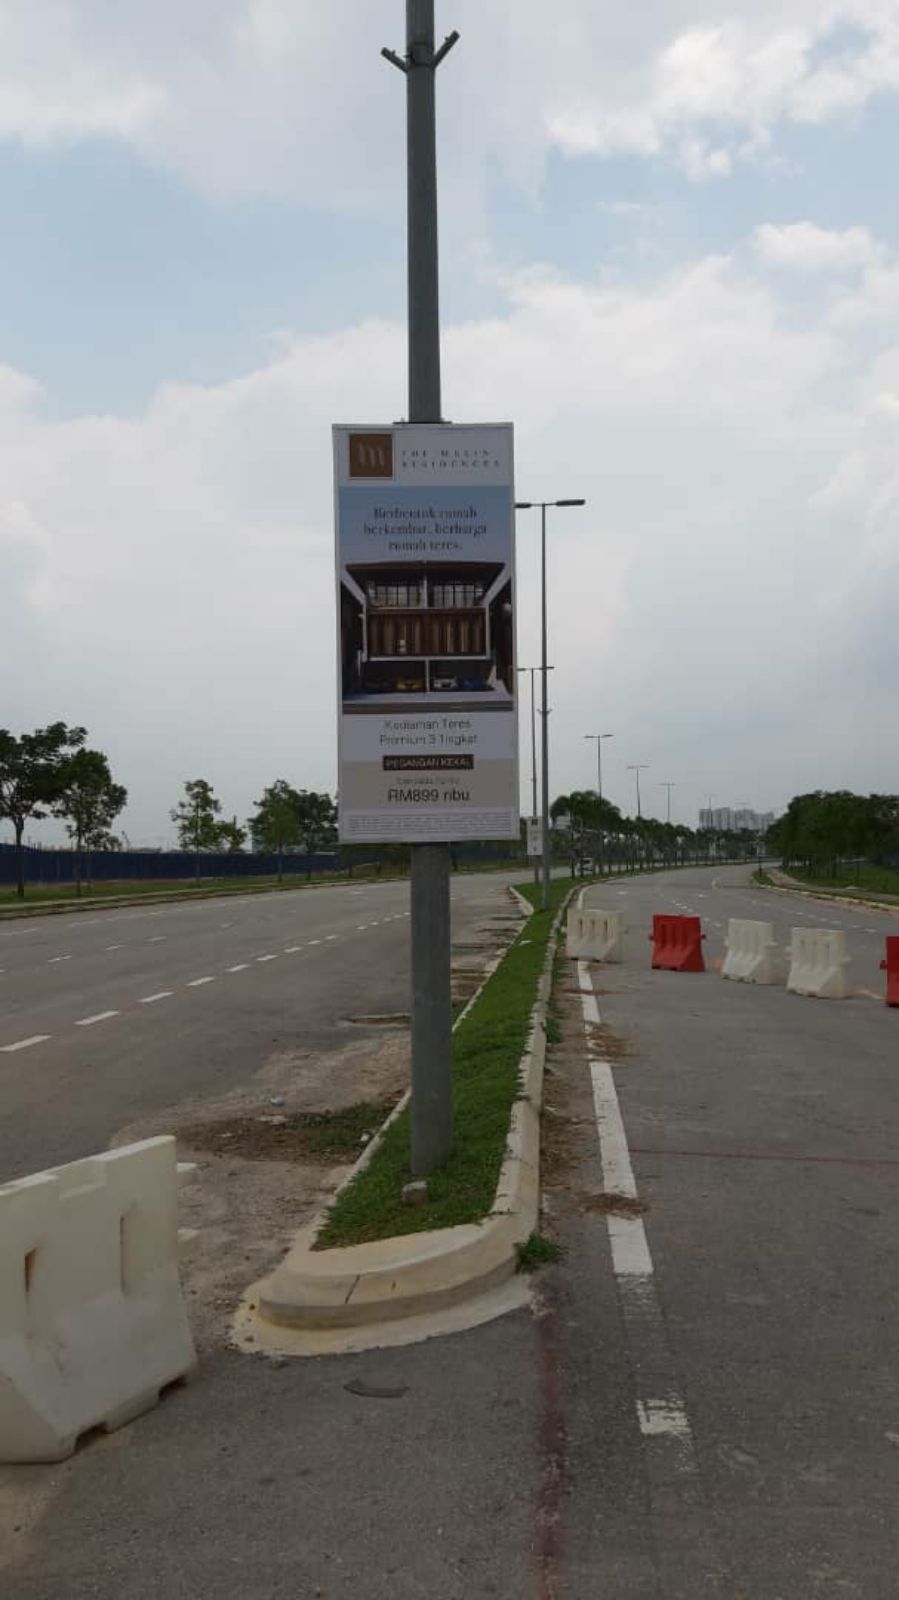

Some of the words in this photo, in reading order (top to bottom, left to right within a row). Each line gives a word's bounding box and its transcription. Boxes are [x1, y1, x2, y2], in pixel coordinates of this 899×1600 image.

[402, 449, 427, 458] THE
[402, 459, 500, 468] RESIDENCES
[374, 506, 436, 519] Berbentuk
[439, 506, 477, 519] rumah
[435, 521, 488, 538] berharga
[388, 538, 426, 550] rumah
[384, 719, 439, 730] Kediaman
[442, 718, 472, 729] Teres
[379, 734, 426, 746] Premium
[429, 734, 436, 744] 3
[440, 733, 478, 746] Tingkat
[388, 788, 439, 802] RM899
[444, 788, 470, 801] ribu
